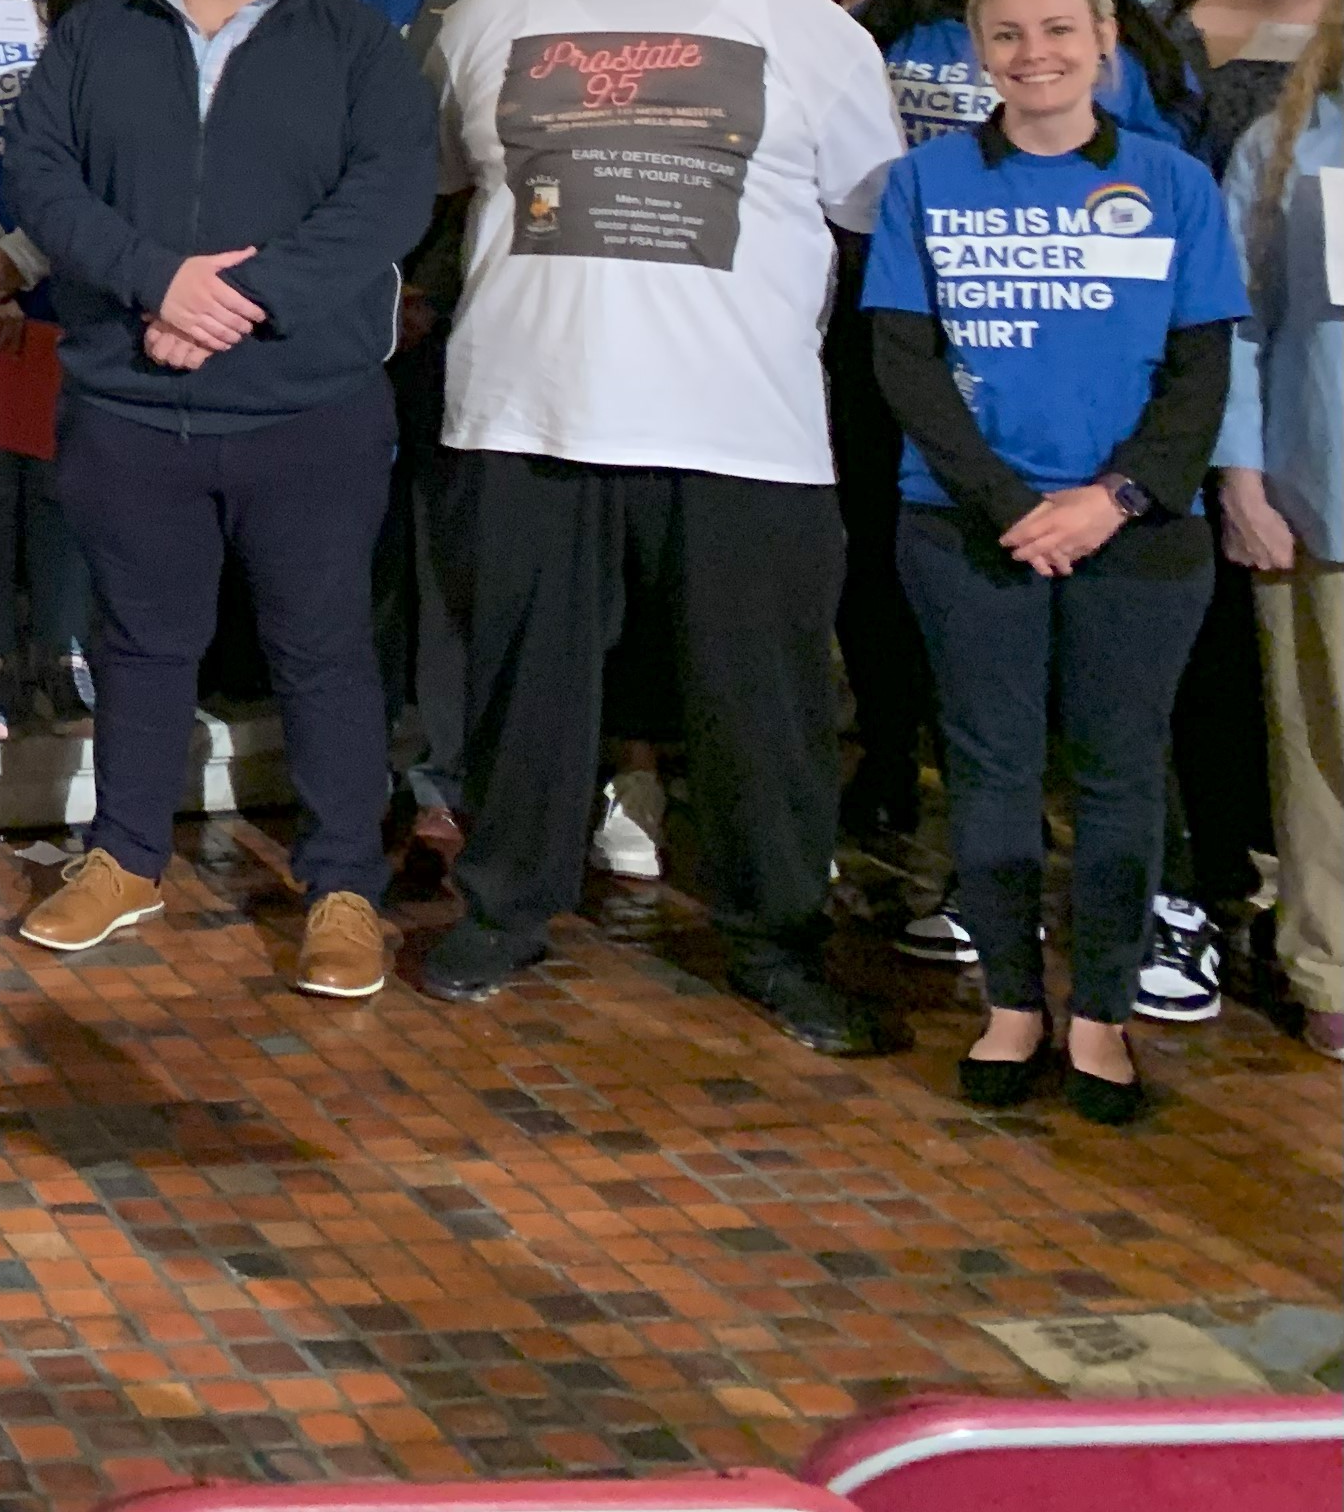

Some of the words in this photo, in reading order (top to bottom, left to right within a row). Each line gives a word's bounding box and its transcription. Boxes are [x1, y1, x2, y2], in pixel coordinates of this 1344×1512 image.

[529, 37, 704, 80] Prostate
[938, 62, 969, 83] IS
[582, 72, 644, 109] 95
[898, 88, 993, 115] NCER
[571, 148, 618, 162] EARLY
[622, 150, 706, 171] DETECTION
[708, 161, 736, 177] CAN
[593, 166, 633, 179] SAVE
[637, 168, 679, 184] YOUR
[683, 173, 713, 189] LIFE
[926, 207, 1008, 235] THIS
[1013, 206, 1051, 235] IS
[931, 245, 1087, 270] CANCER
[936, 280, 1115, 311] FIGHTING
